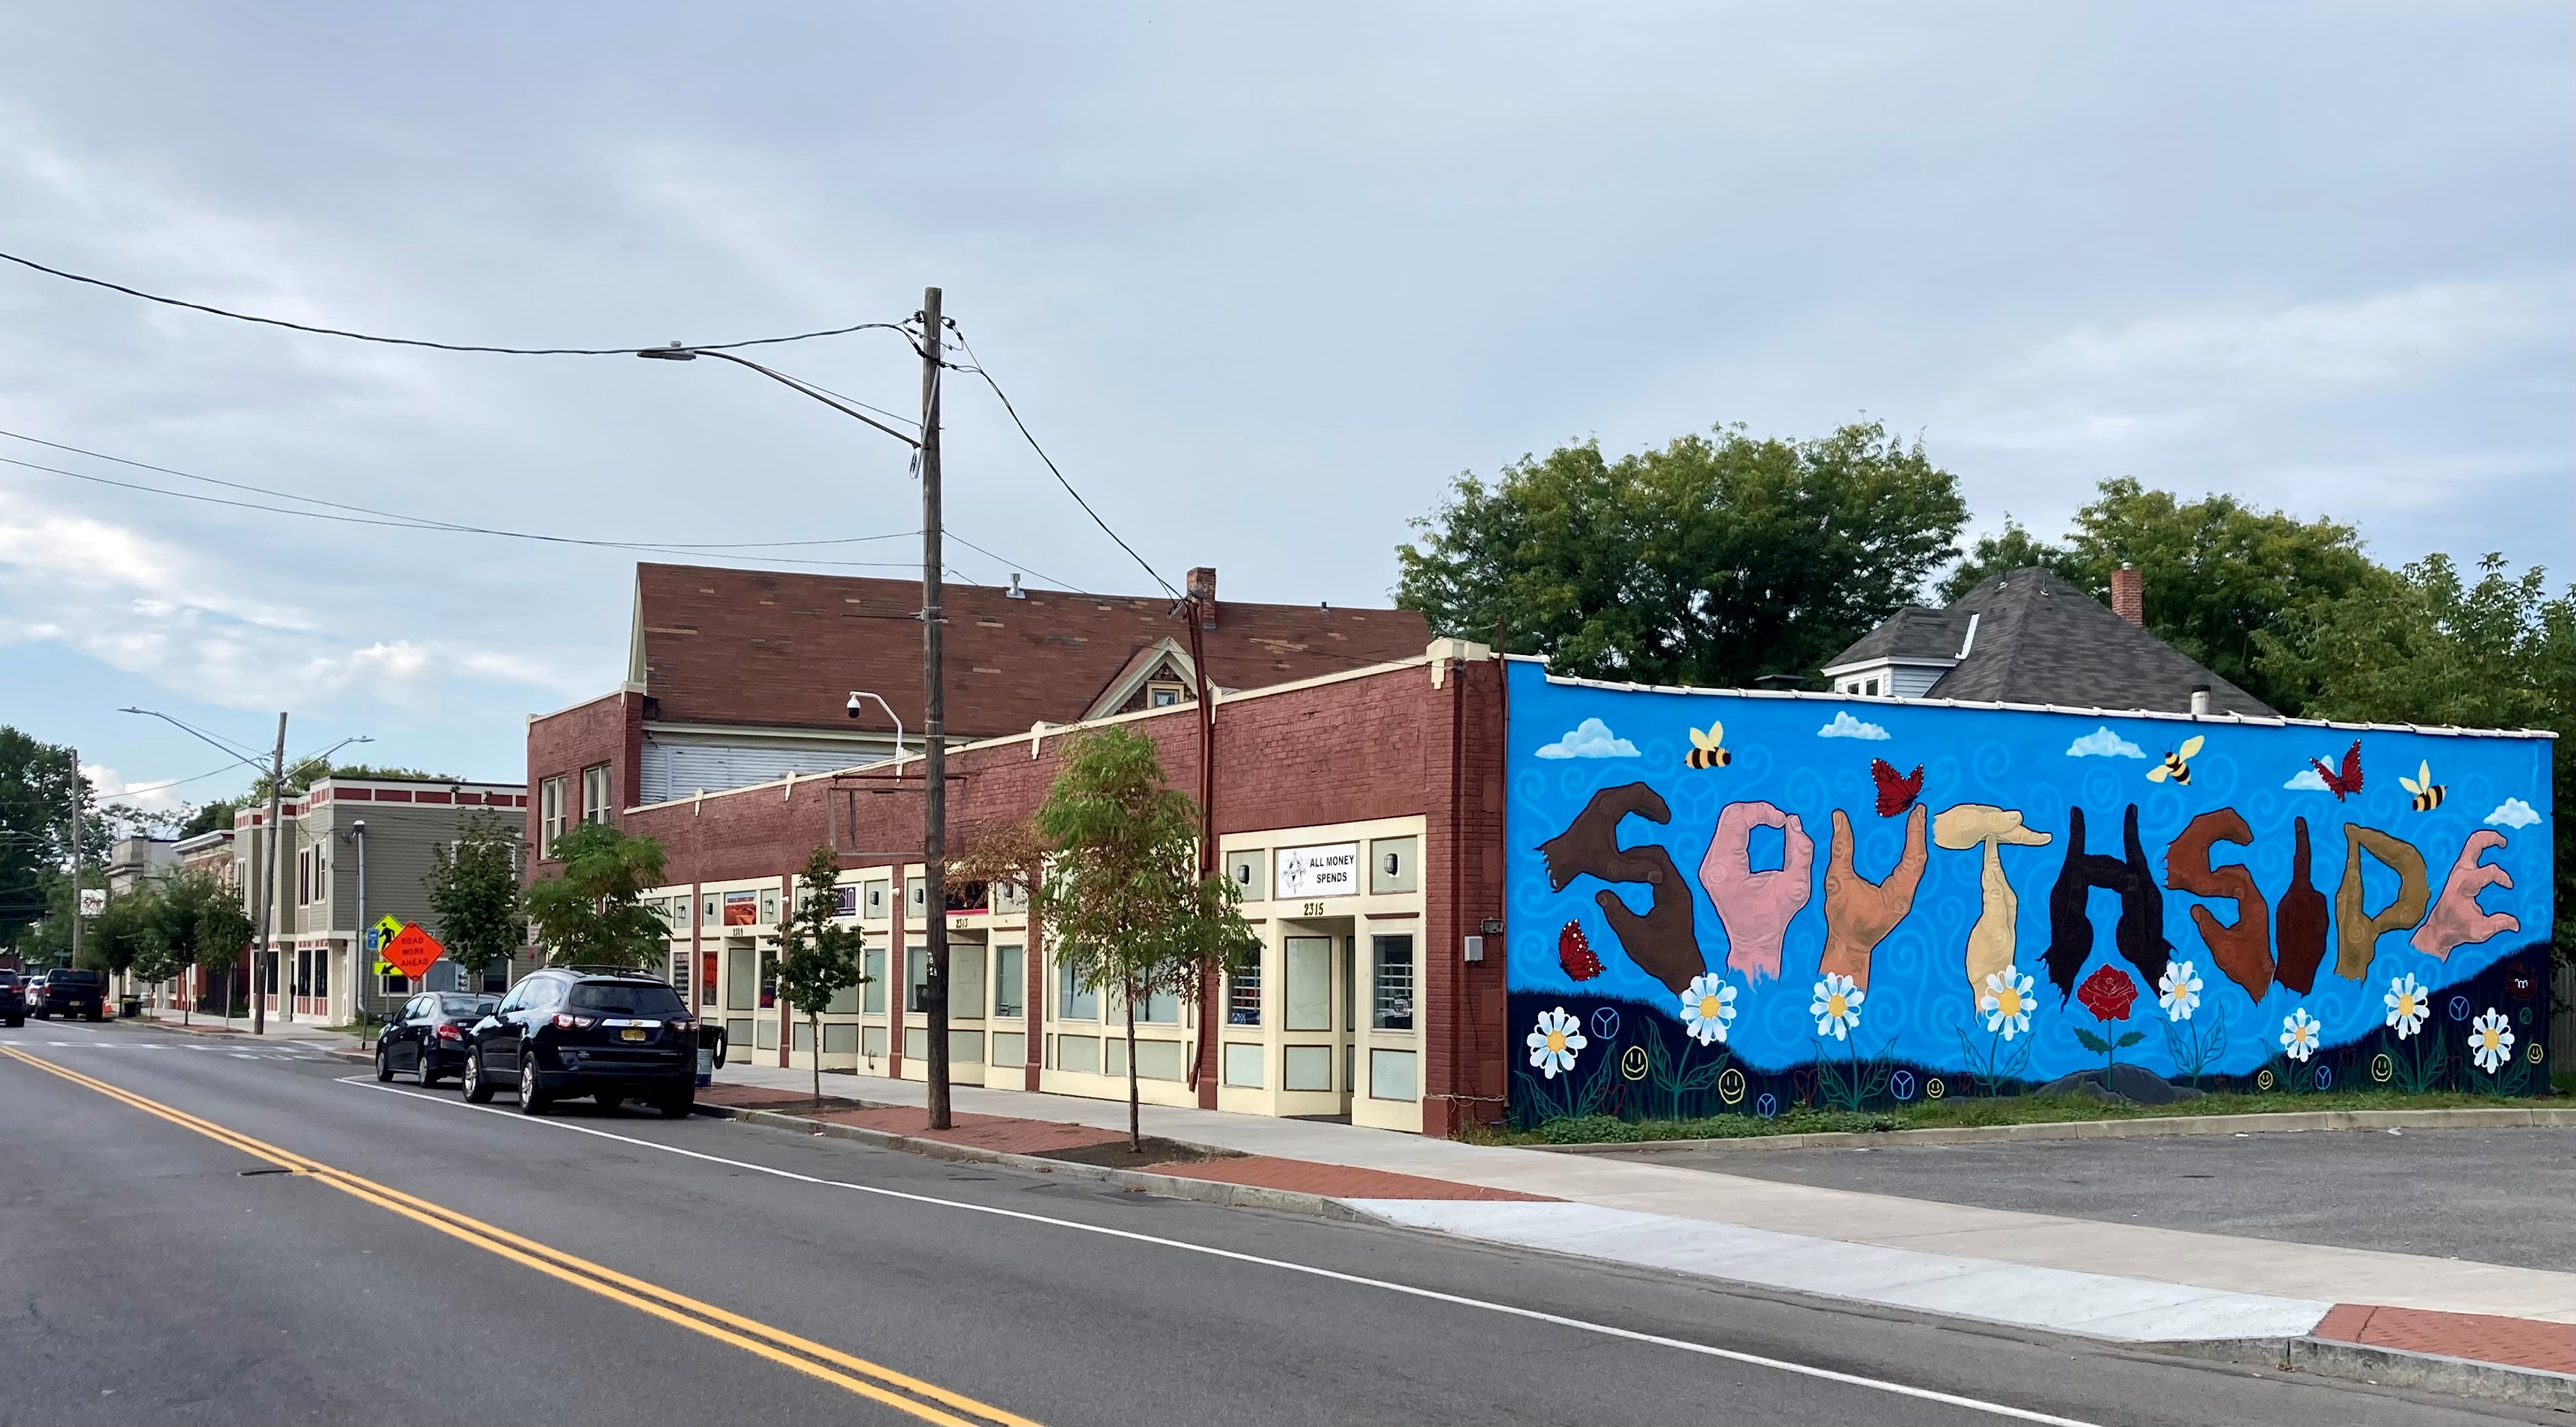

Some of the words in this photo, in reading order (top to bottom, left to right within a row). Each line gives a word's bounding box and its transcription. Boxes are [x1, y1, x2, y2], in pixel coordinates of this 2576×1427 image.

[1309, 857, 1325, 867] ALL
[1326, 854, 1355, 866] MONEY
[1316, 871, 1348, 884] SPENDS
[1303, 902, 1324, 916] 2315
[956, 918, 968, 928] 2313
[401, 937, 424, 945] ROAD
[402, 947, 425, 956] WORK
[401, 958, 429, 966] AHEAD
